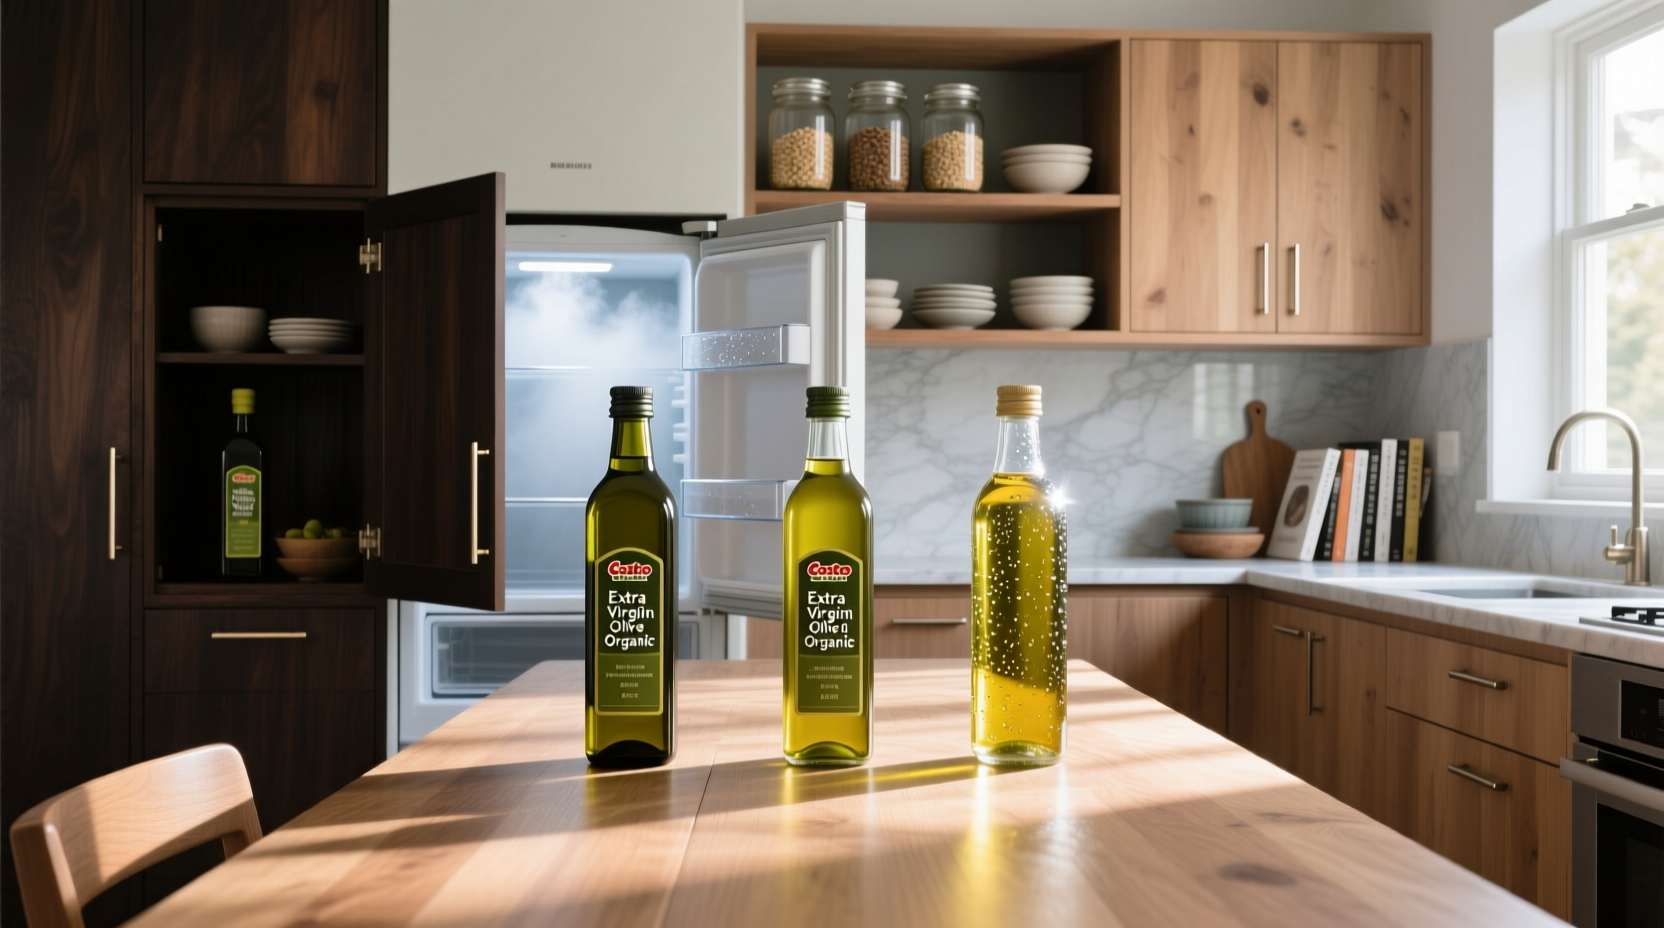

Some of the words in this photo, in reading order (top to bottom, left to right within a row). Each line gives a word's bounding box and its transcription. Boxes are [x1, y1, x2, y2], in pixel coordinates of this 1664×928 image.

[609, 590, 646, 604] Extra
[808, 591, 845, 605] Extra
[605, 634, 655, 651] Organic
[805, 634, 855, 651] Organic
